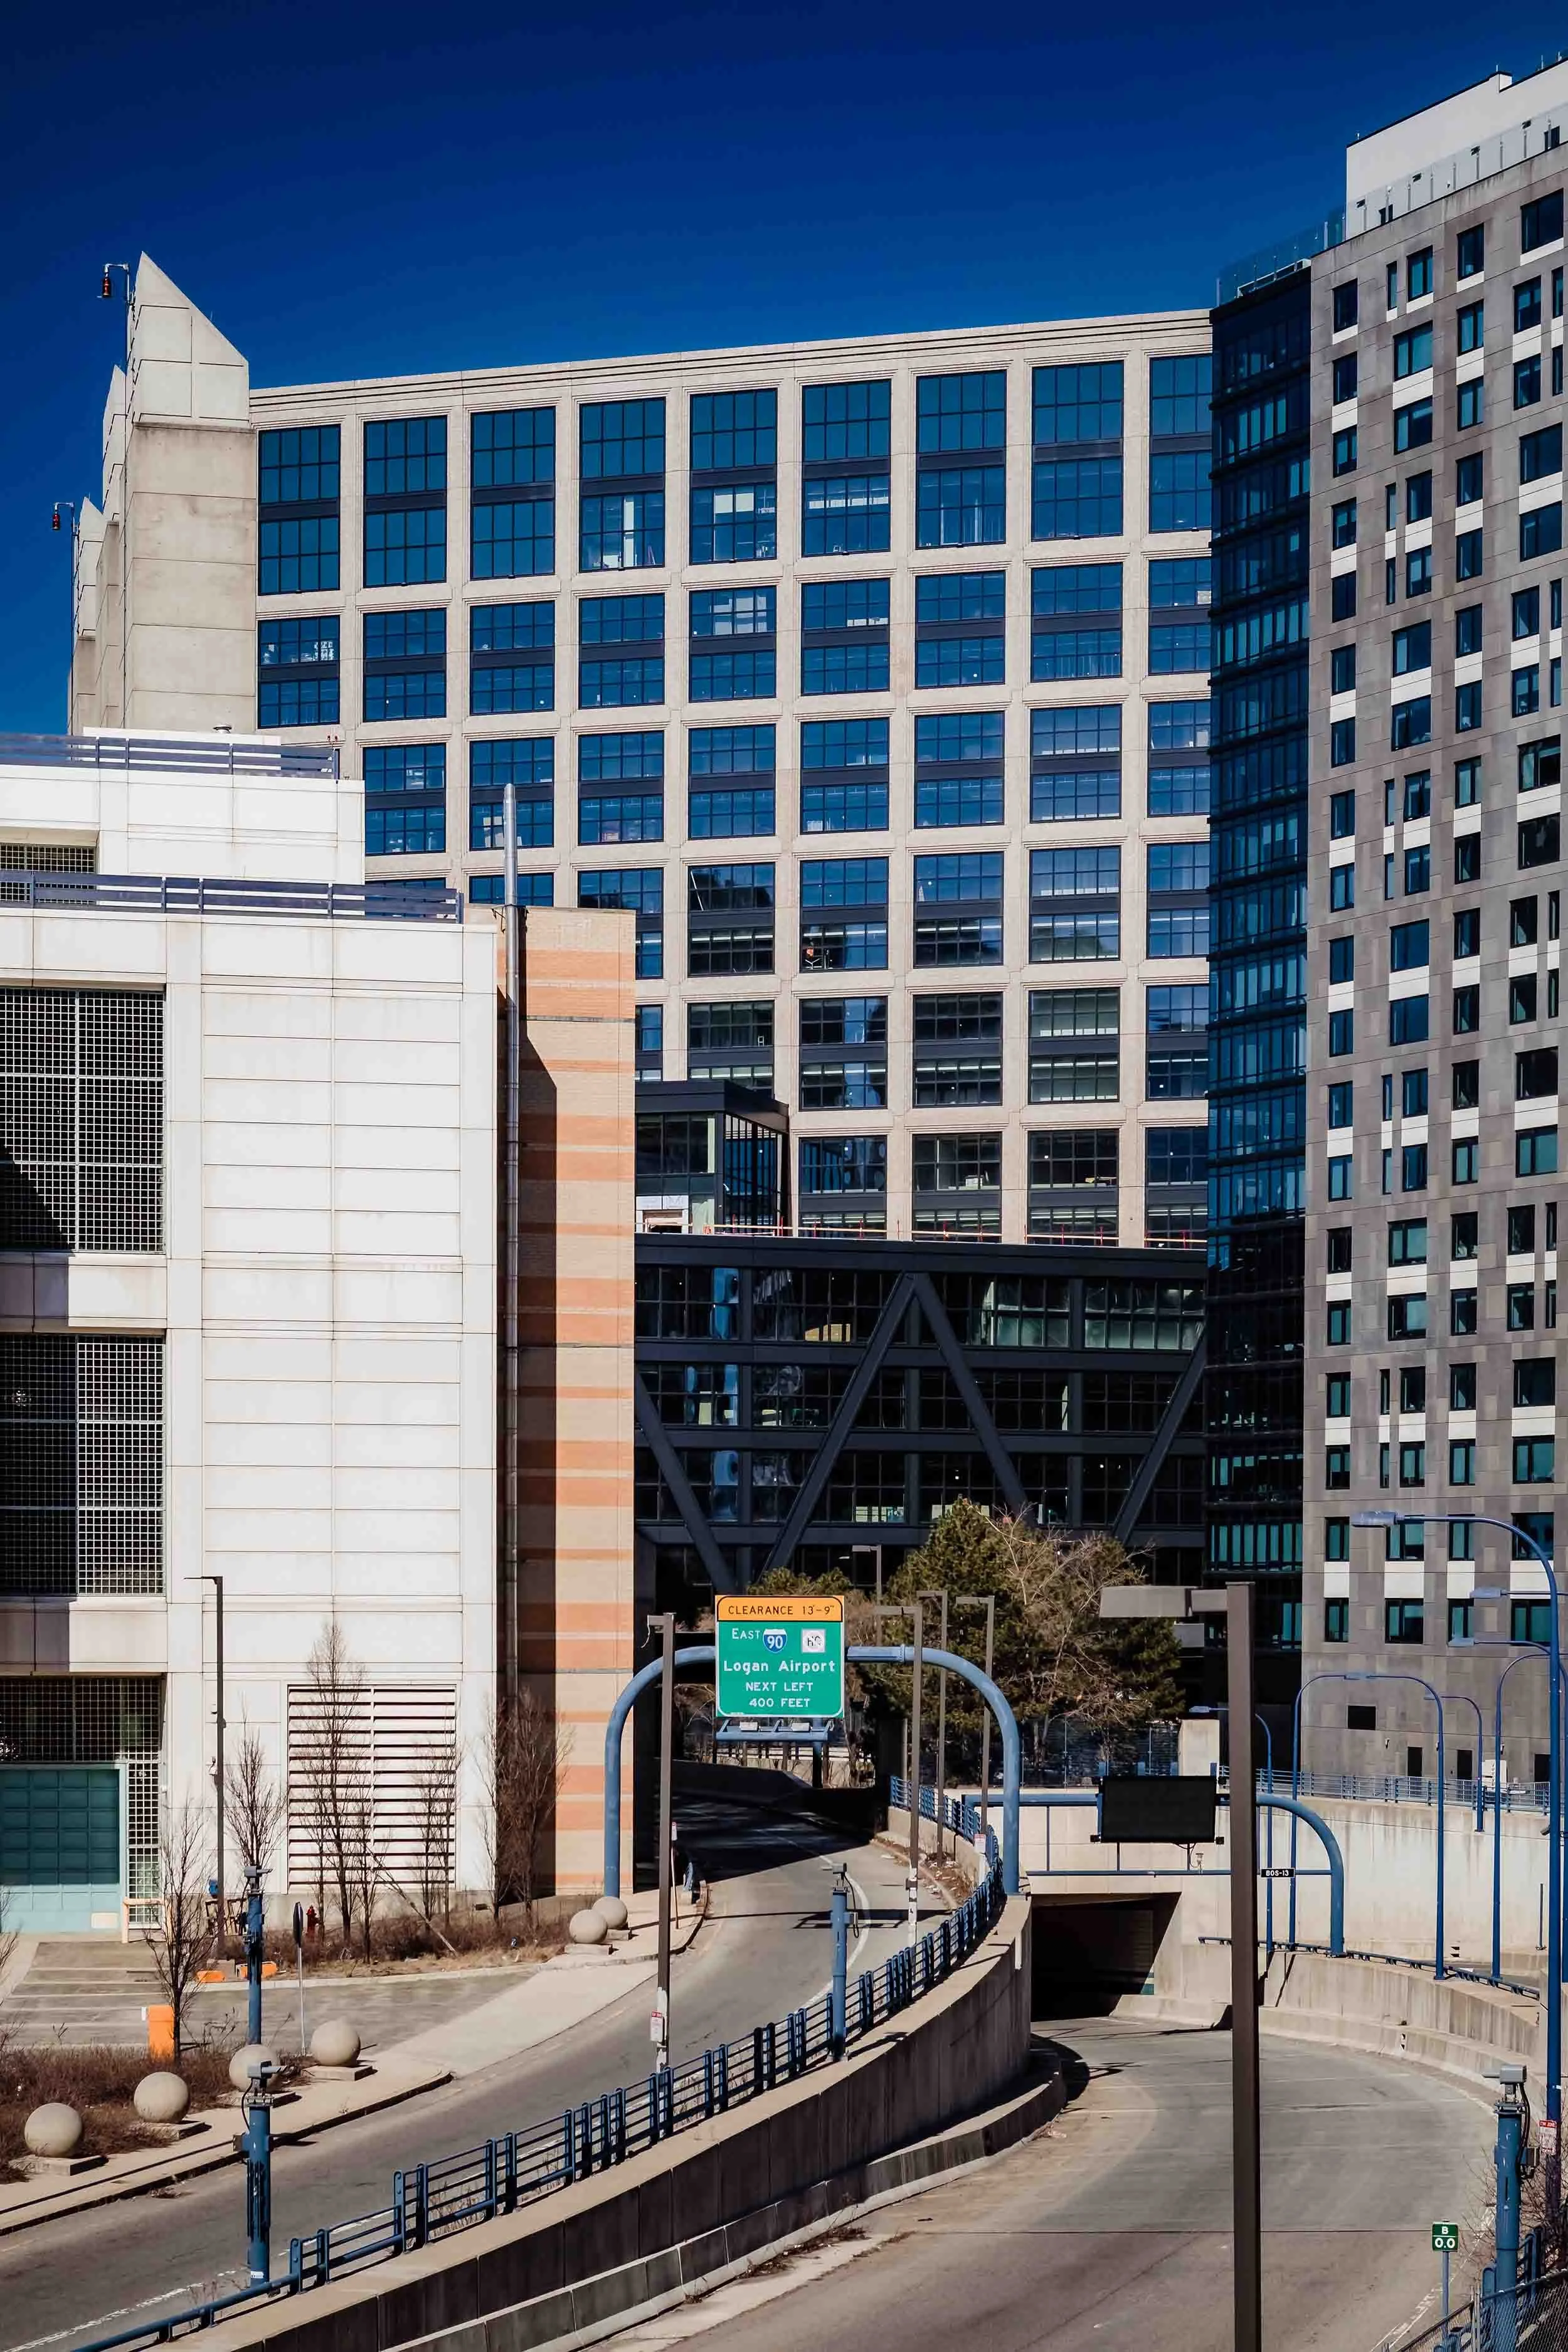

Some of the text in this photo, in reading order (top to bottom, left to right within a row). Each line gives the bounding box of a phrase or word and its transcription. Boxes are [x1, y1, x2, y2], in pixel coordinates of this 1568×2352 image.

[728, 1606, 793, 1615] CLEARANCE
[732, 1628, 760, 1640] EAST
[767, 1635, 783, 1649] 90
[724, 1660, 835, 1675] Logan Airport
[746, 1682, 813, 1692] NEXT LEFT
[749, 1698, 810, 1707] 400 FEET
[1441, 2226, 1449, 2234] B
[1434, 2237, 1456, 2249] 0.0
